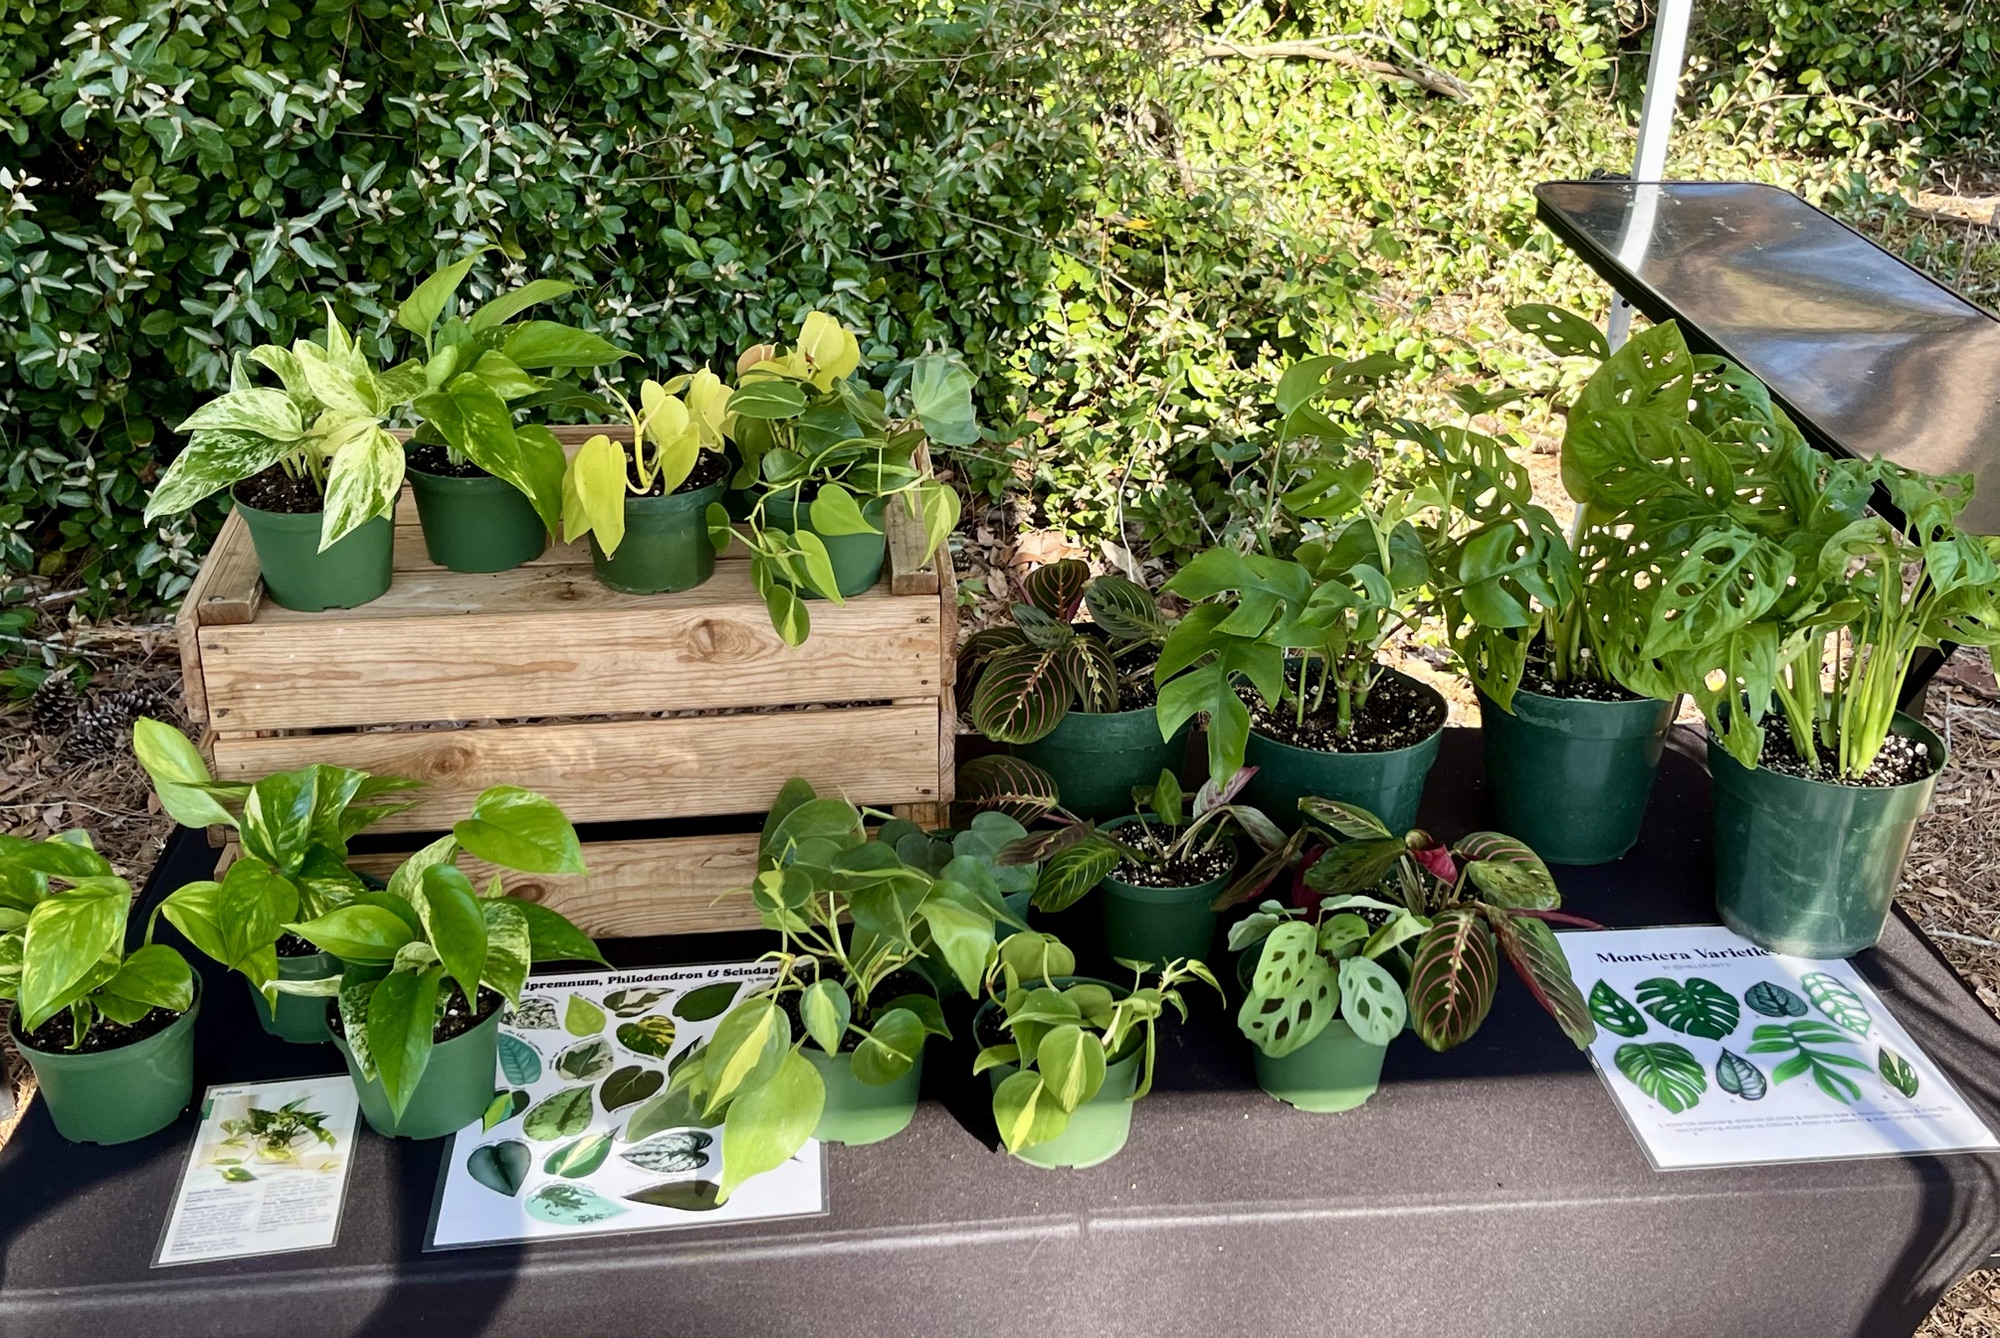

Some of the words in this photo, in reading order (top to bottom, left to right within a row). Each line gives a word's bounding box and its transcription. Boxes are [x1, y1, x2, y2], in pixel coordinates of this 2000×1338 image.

[1596, 952, 1692, 964] Monstera
[1694, 947, 1781, 960] Varietie
[524, 979, 603, 991] ipremnum,
[607, 972, 703, 985] Philodendron
[707, 969, 719, 978] &
[723, 966, 779, 977] Scindap
